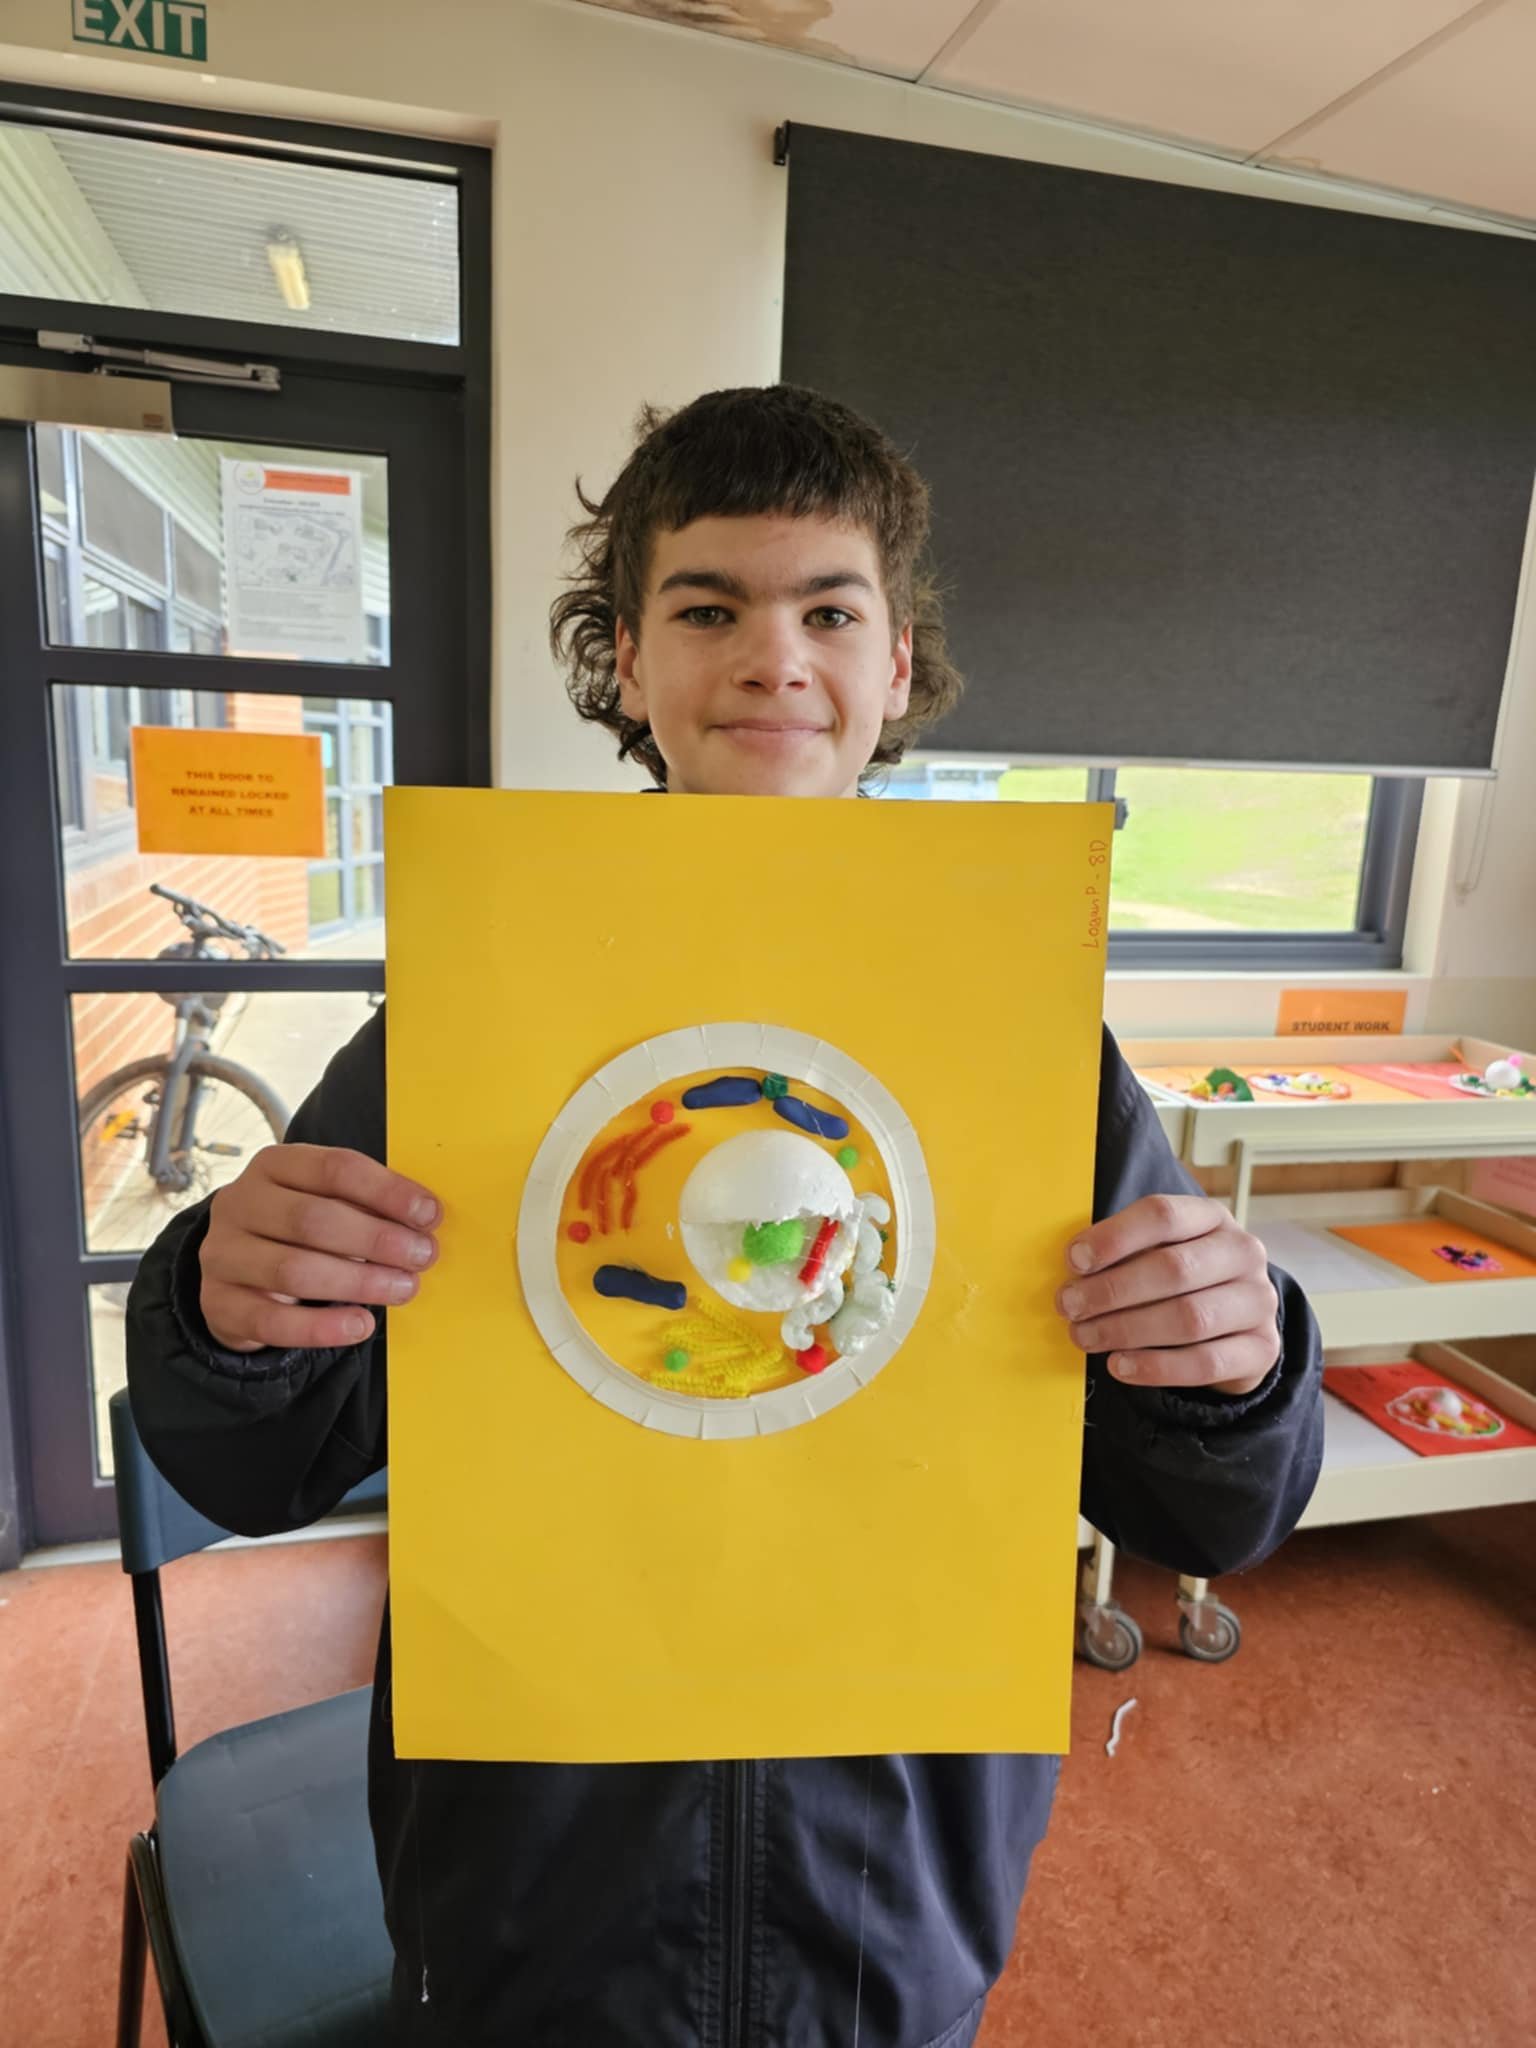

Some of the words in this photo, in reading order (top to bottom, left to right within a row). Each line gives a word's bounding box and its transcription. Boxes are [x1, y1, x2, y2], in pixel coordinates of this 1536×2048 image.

[72, 0, 206, 56] EXIT
[186, 770, 214, 780] THIS
[219, 772, 252, 782] DOOR
[257, 773, 274, 783] TO
[171, 787, 236, 798] REMAINED
[240, 791, 289, 800] LOCKED
[189, 805, 205, 815] AT
[210, 807, 232, 816] ALL
[237, 808, 274, 817] TIMES
[1292, 1021, 1350, 1032] STUDENT
[1353, 1021, 1390, 1032] WORK
